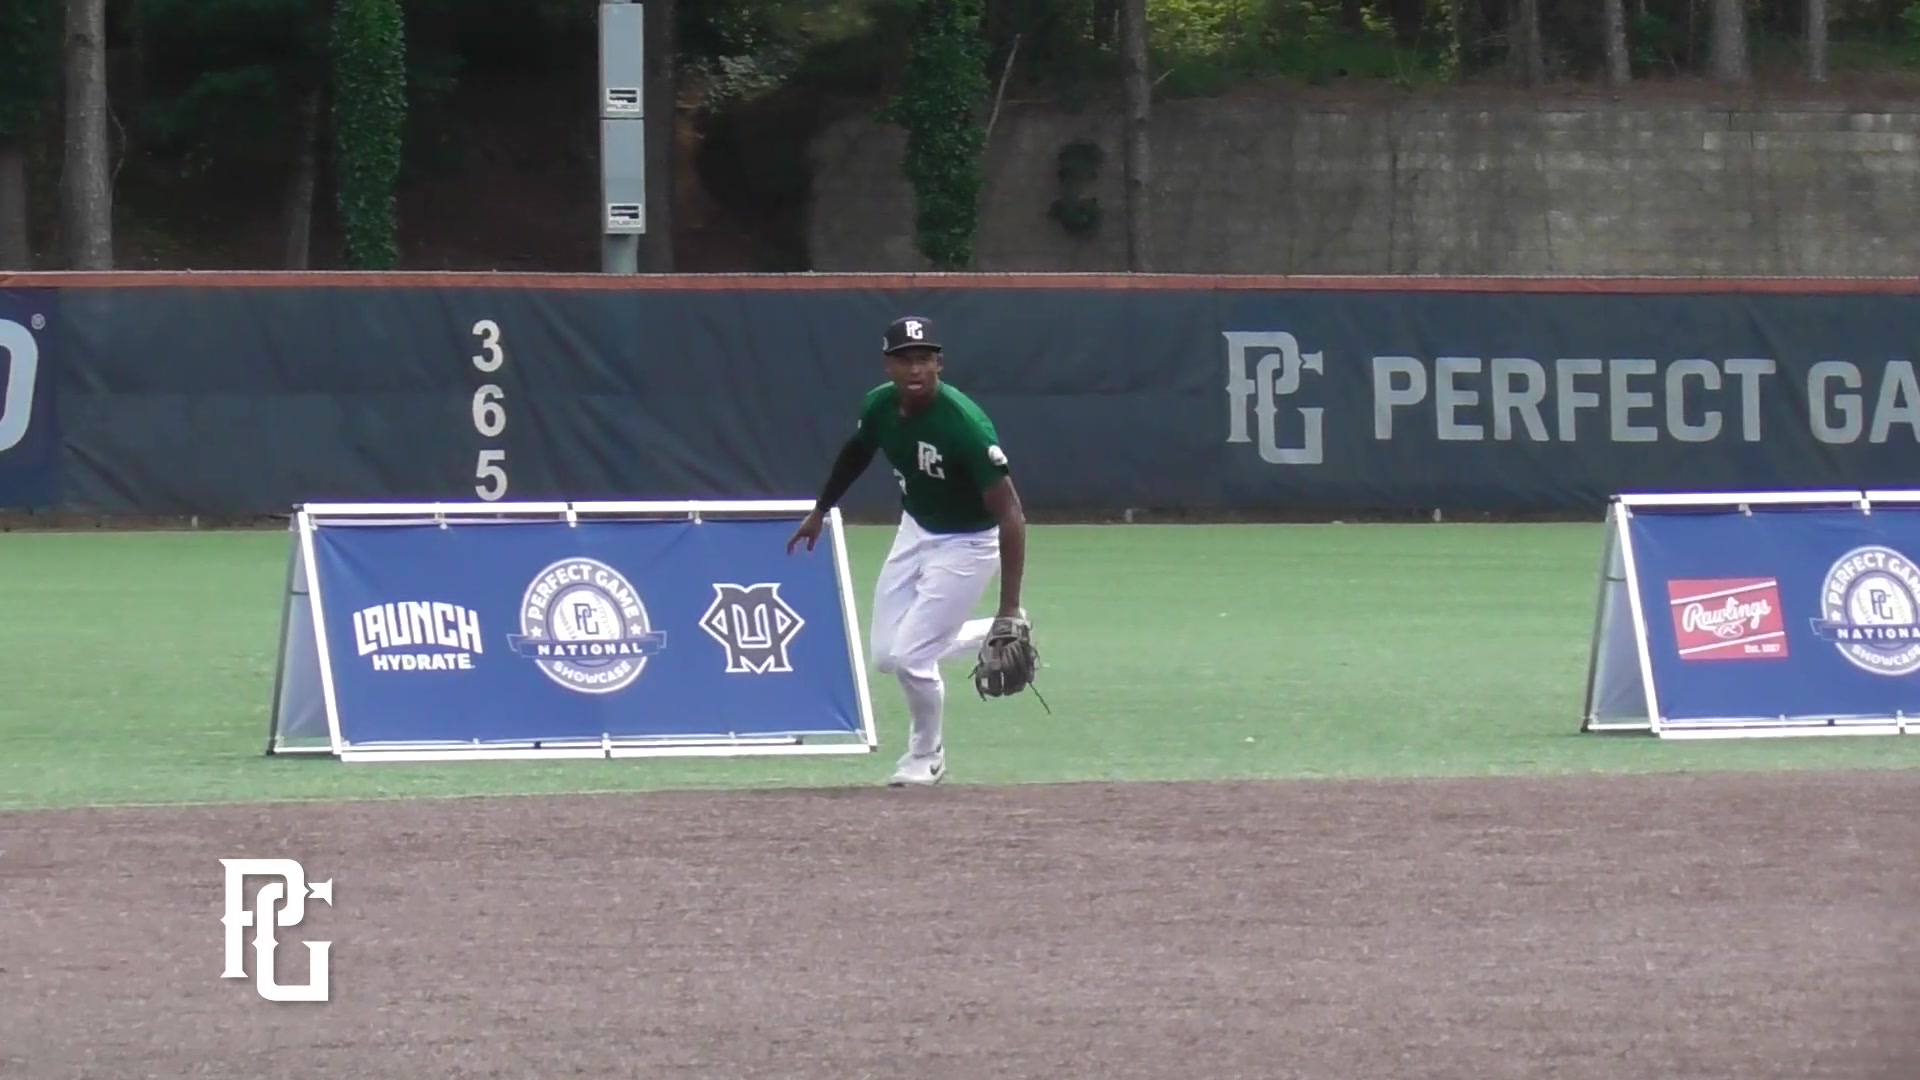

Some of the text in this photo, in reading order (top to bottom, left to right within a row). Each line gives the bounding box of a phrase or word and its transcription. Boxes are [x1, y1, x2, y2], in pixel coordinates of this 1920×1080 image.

[1221, 331, 1325, 465] PG
[1372, 356, 1776, 443] PERFECT
[527, 563, 640, 621] PERFECT GAME
[1828, 552, 1920, 606] PERFECT GAM
[353, 600, 483, 656] LAUNCH
[1682, 596, 1772, 633] Rawlings
[372, 652, 472, 671] HYDRATE
[536, 642, 643, 656] NATIONAL
[552, 660, 632, 684] SHOWCASE
